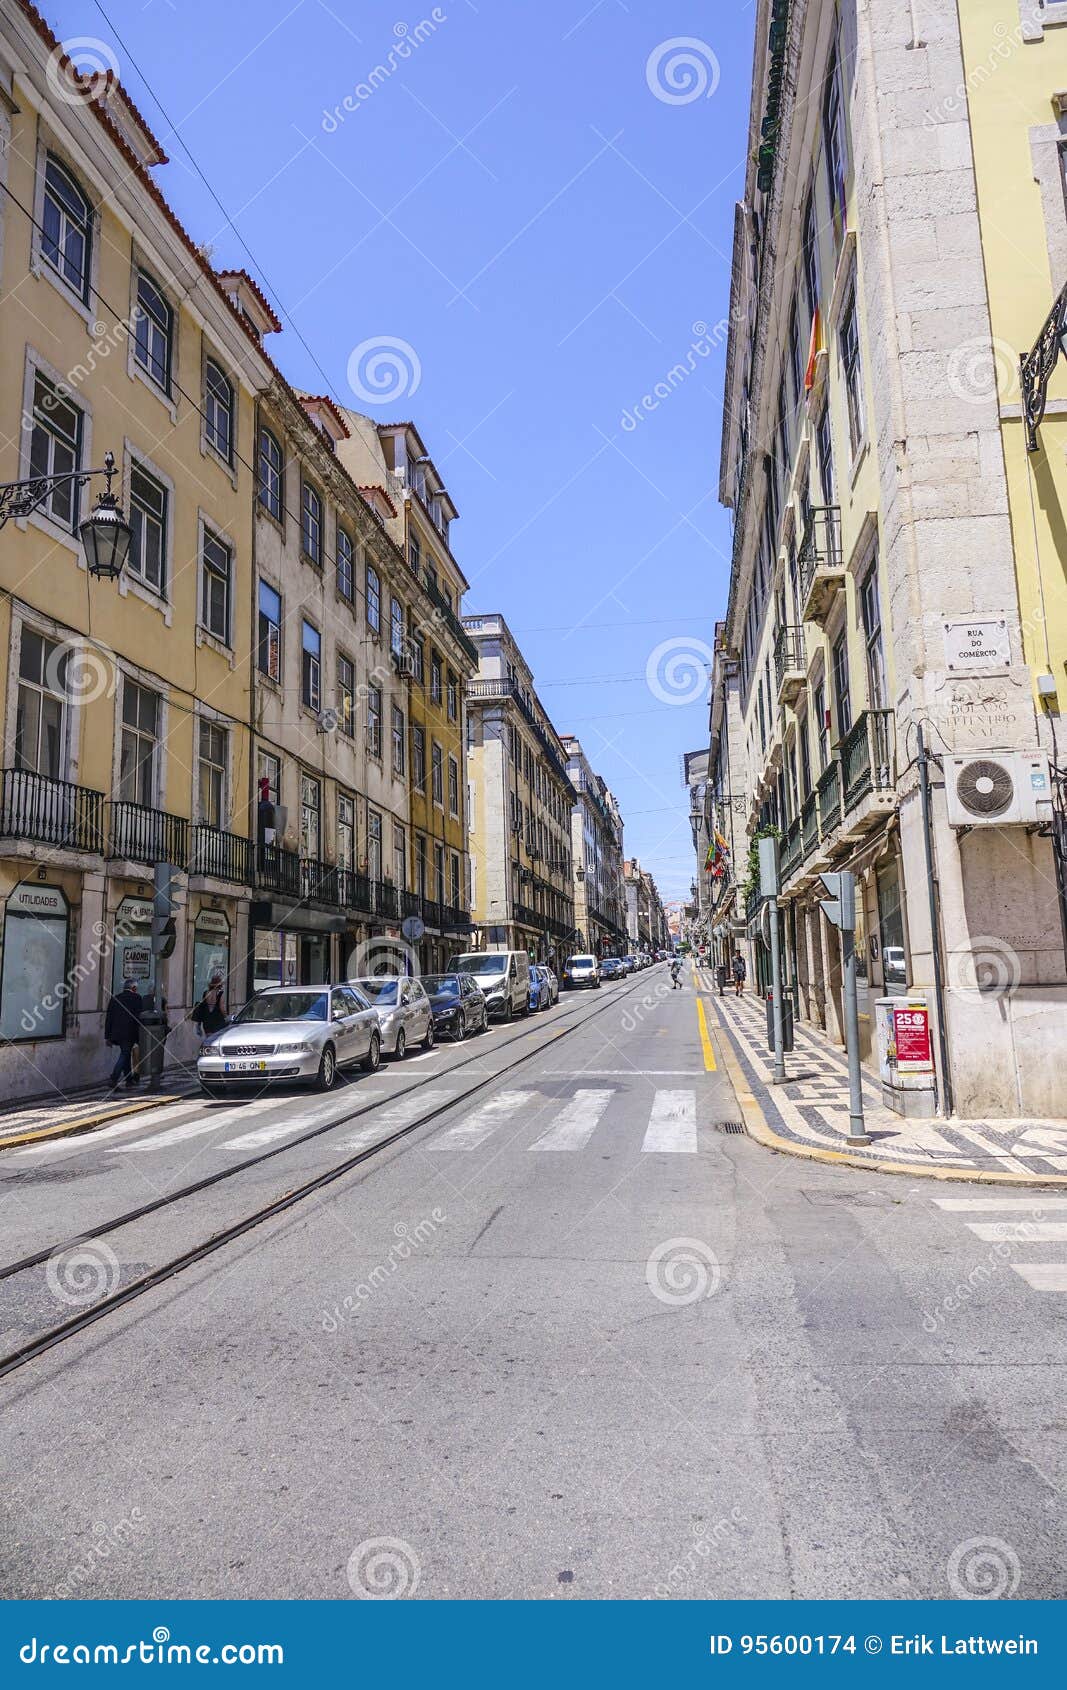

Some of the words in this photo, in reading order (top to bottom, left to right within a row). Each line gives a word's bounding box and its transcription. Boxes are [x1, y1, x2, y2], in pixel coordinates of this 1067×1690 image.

[967, 630, 984, 638] RUA
[958, 648, 997, 659] COMÉRCIO
[19, 893, 58, 907] UTILIDADES
